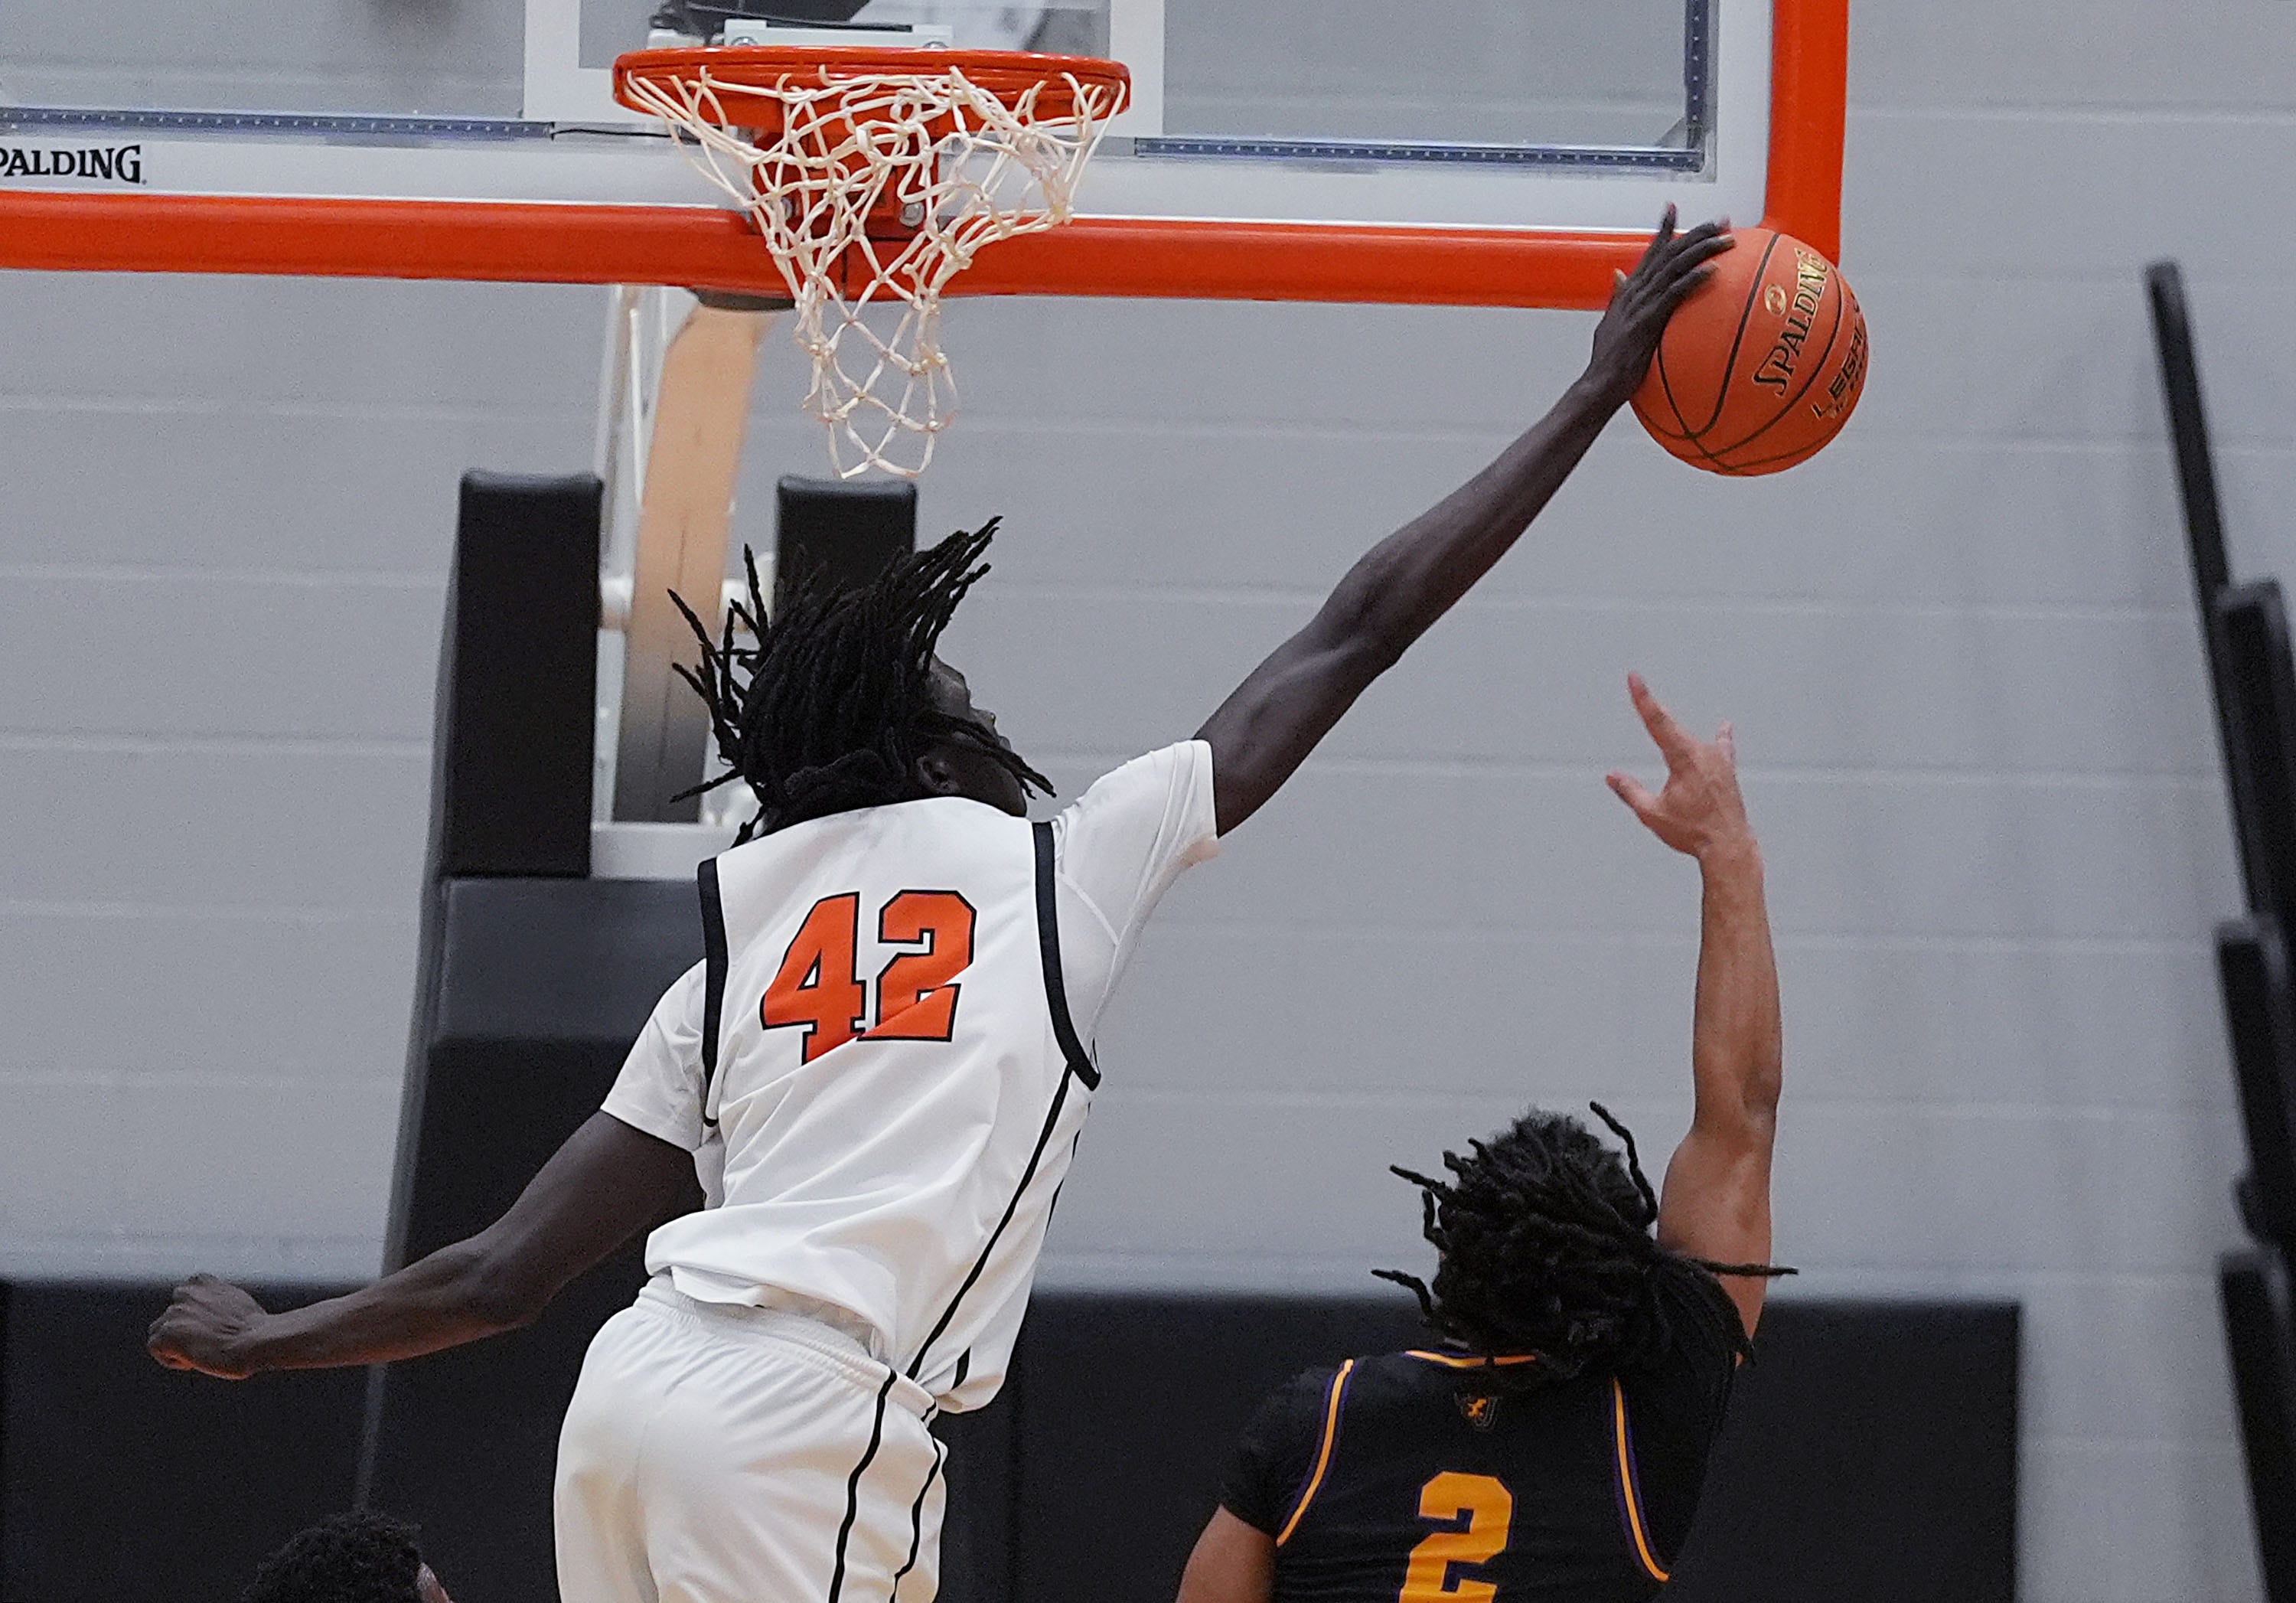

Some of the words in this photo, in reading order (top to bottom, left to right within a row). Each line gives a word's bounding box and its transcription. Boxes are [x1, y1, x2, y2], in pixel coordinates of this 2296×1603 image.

[1752, 247, 1828, 397] SPALDING
[759, 889, 977, 1066] 42
[1398, 1471, 1513, 1603] 2
